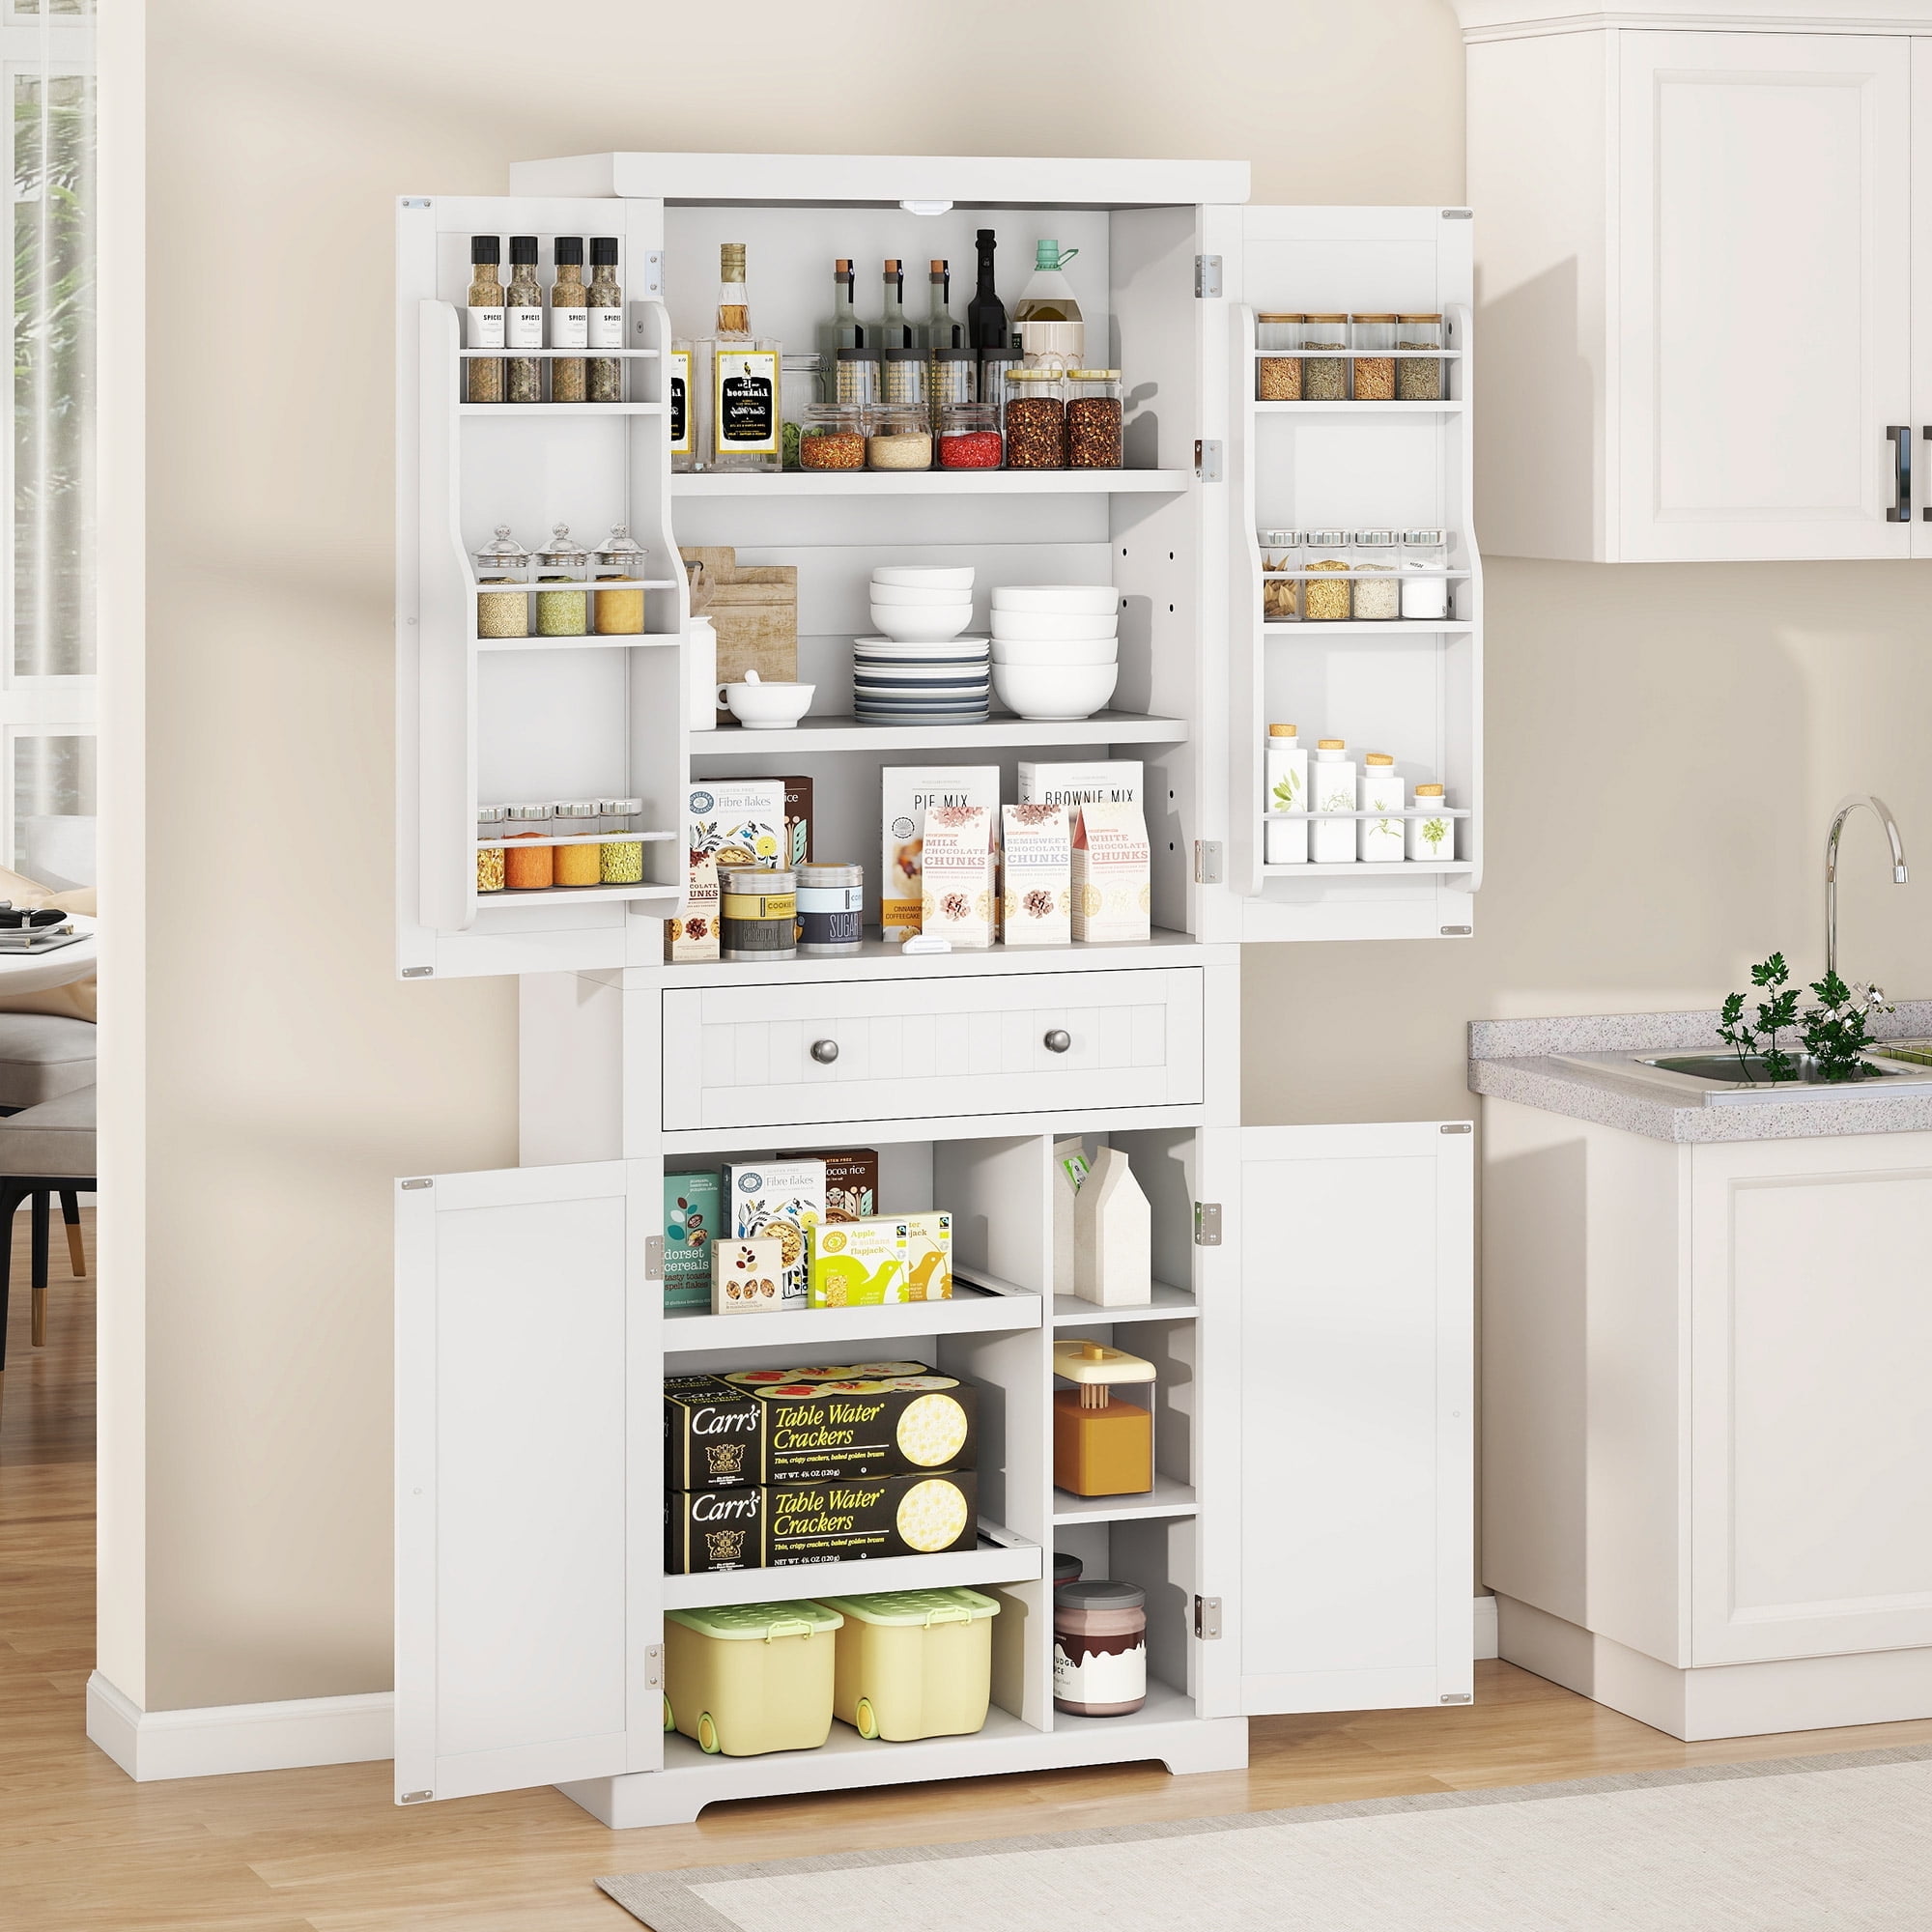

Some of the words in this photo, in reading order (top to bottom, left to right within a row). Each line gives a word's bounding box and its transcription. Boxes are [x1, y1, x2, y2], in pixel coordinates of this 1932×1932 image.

[784, 792, 799, 802] ice
[1111, 789, 1134, 802] MIX
[719, 797, 743, 807] Fibre
[745, 796, 771, 806] flakes
[914, 794, 935, 810] PIE
[944, 794, 968, 808] MIX
[1008, 854, 1068, 863] CHUNKS
[1092, 850, 1149, 861] CHUNKS
[924, 857, 985, 866] CHUNKS
[830, 914, 858, 937] SUGAR
[850, 1165, 866, 1175] rice
[766, 1177, 788, 1186] Fibre
[790, 1175, 813, 1185] flakes
[910, 1229, 927, 1237] jack
[665, 1248, 704, 1260] dorset
[851, 1246, 884, 1256] flapjack
[665, 1260, 709, 1271] cereals
[692, 1405, 760, 1435] Carr's
[776, 1405, 824, 1428] Table
[829, 1404, 881, 1425] Water
[774, 1426, 854, 1449] Crackers
[848, 1452, 867, 1461] golden
[692, 1491, 760, 1521] Carr's
[776, 1492, 824, 1514] Table
[829, 1490, 881, 1510] Water
[774, 1512, 854, 1535] Crackers
[1055, 1658, 1074, 1667] UDGE
